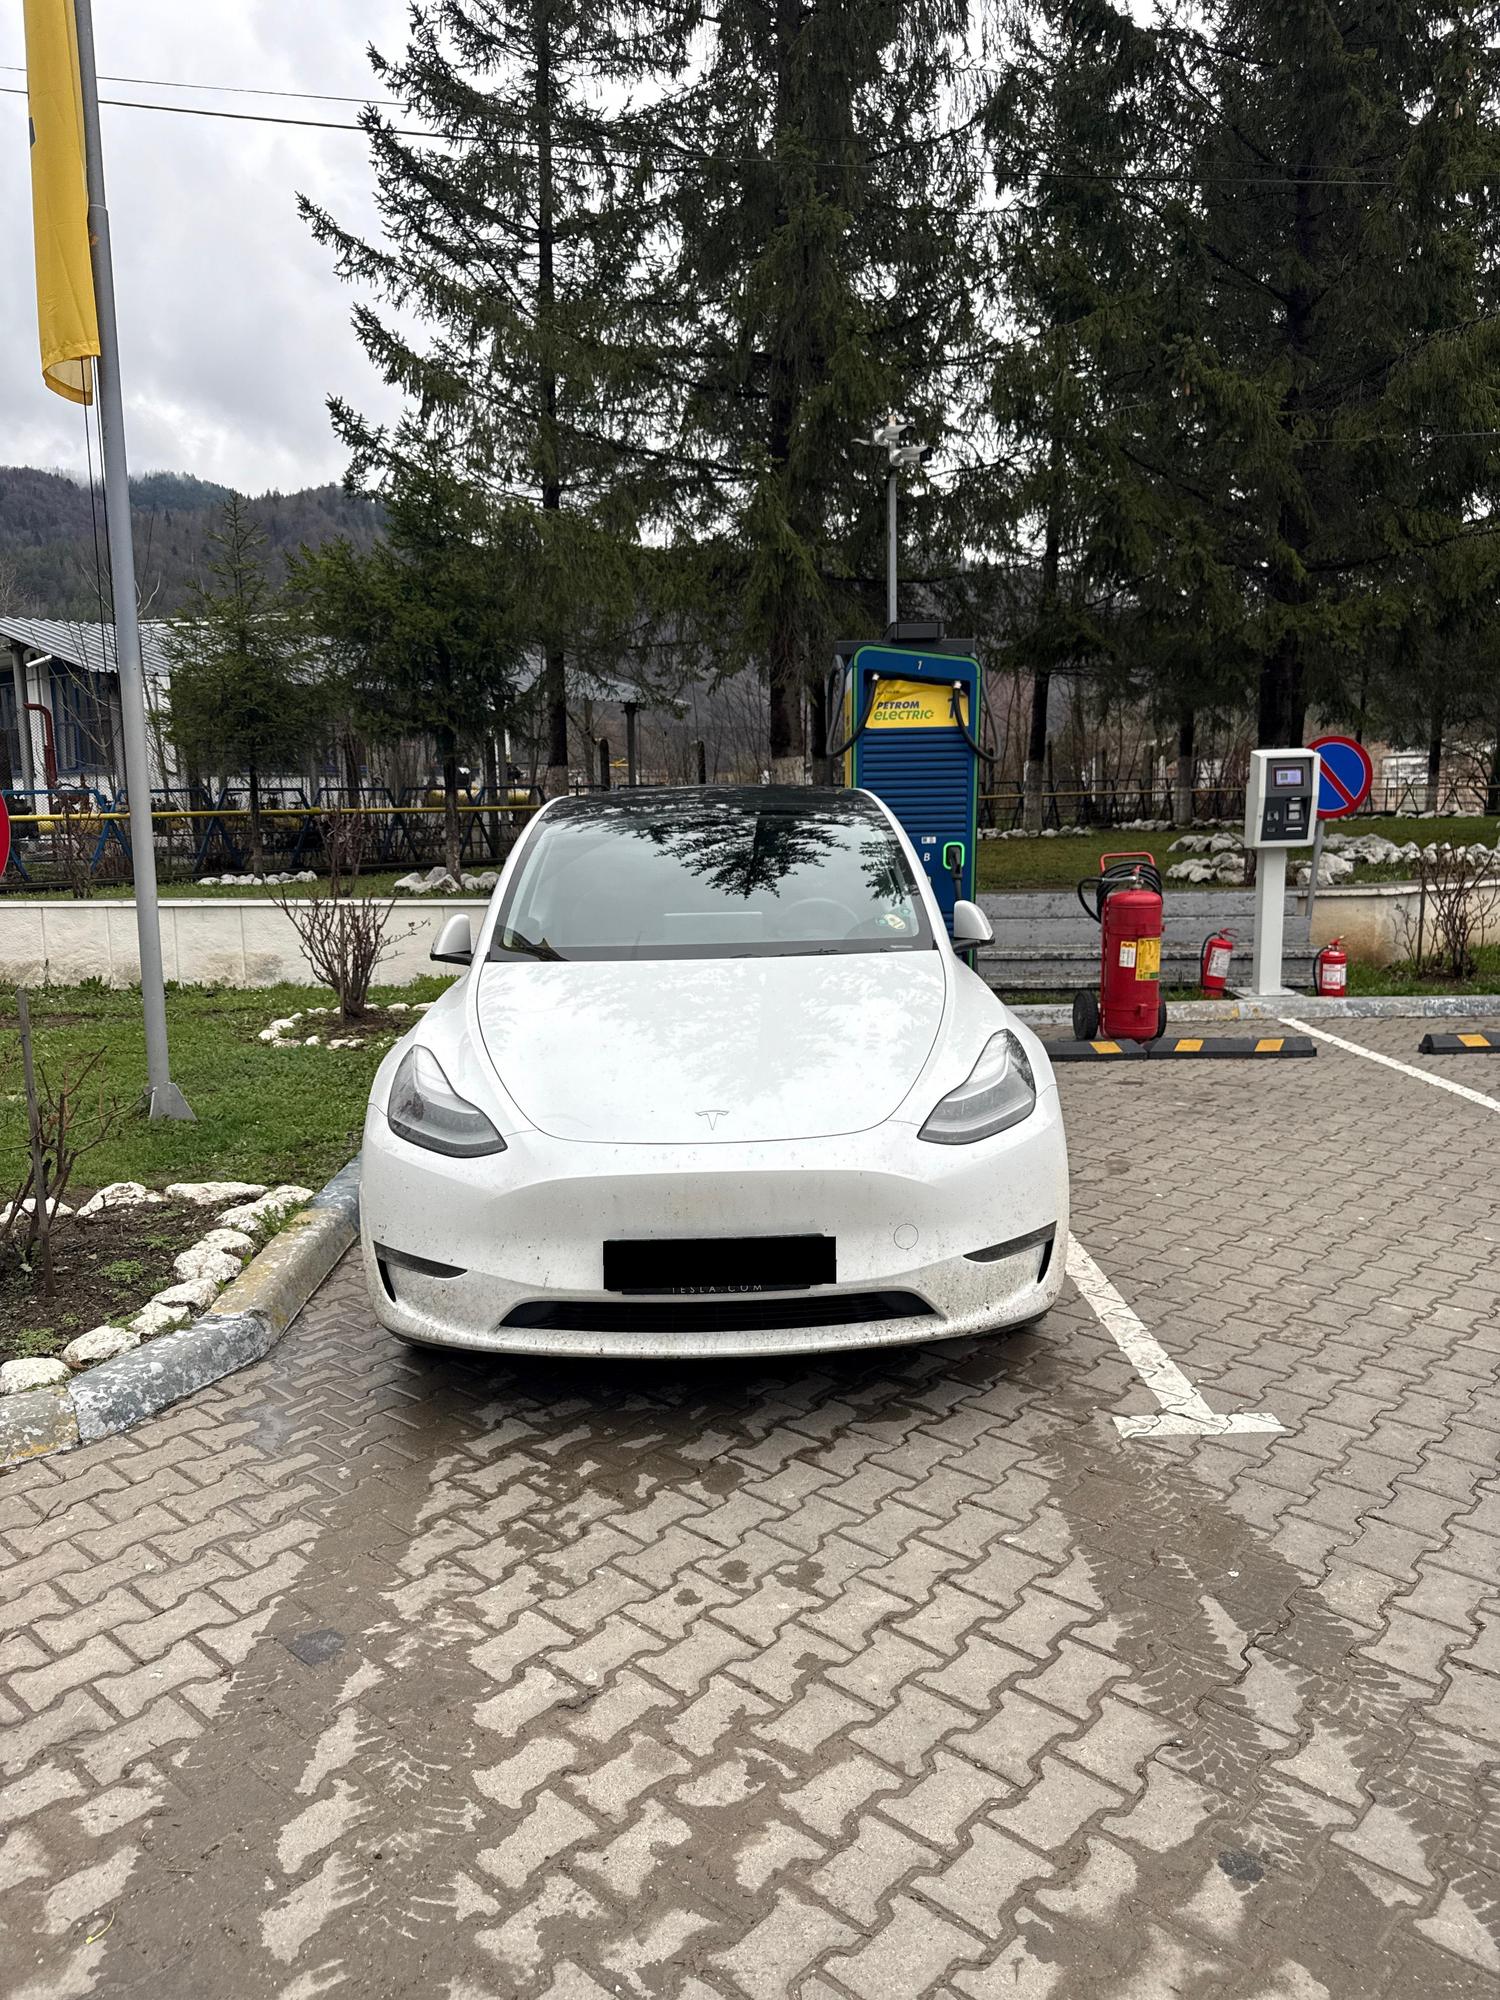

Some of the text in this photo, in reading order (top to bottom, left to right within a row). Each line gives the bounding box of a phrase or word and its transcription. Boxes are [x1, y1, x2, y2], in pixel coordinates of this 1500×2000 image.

[917, 660, 923, 670] 1
[876, 700, 920, 710] PETROM
[923, 852, 931, 862] B
